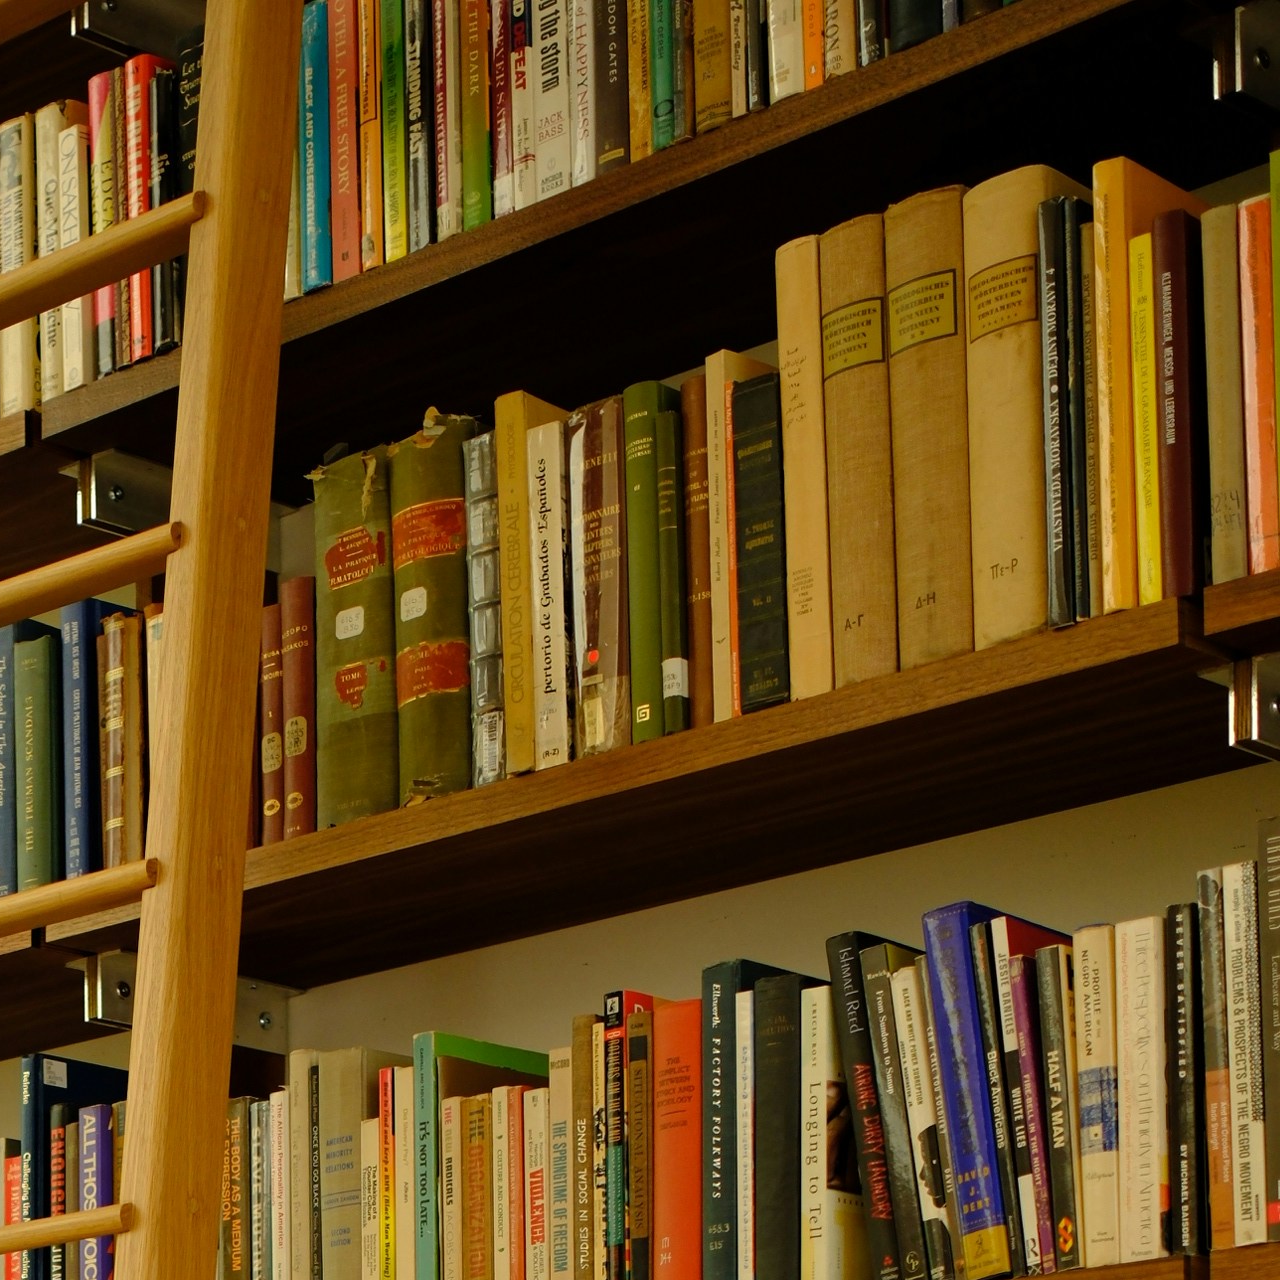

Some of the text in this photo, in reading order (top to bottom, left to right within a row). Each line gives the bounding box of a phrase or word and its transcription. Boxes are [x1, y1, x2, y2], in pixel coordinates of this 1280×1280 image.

[467, 10, 480, 96] THE DARK
[337, 84, 348, 131] FREE
[338, 133, 350, 194] STORY
[1046, 278, 1058, 332] MORAVY
[538, 540, 554, 606] Grabados
[539, 612, 551, 631] de
[1176, 982, 1187, 1079] SATISFIED
[577, 1119, 586, 1163] CHANGE
[806, 1082, 823, 1240] Longing to Tell
[470, 1144, 486, 1277] ORGANIZATION
[530, 1168, 545, 1245] VIOLENCE
[578, 1168, 588, 1204] SOCIAL
[52, 1247, 62, 1280] JUAN
[580, 1226, 589, 1269] STUDIES
